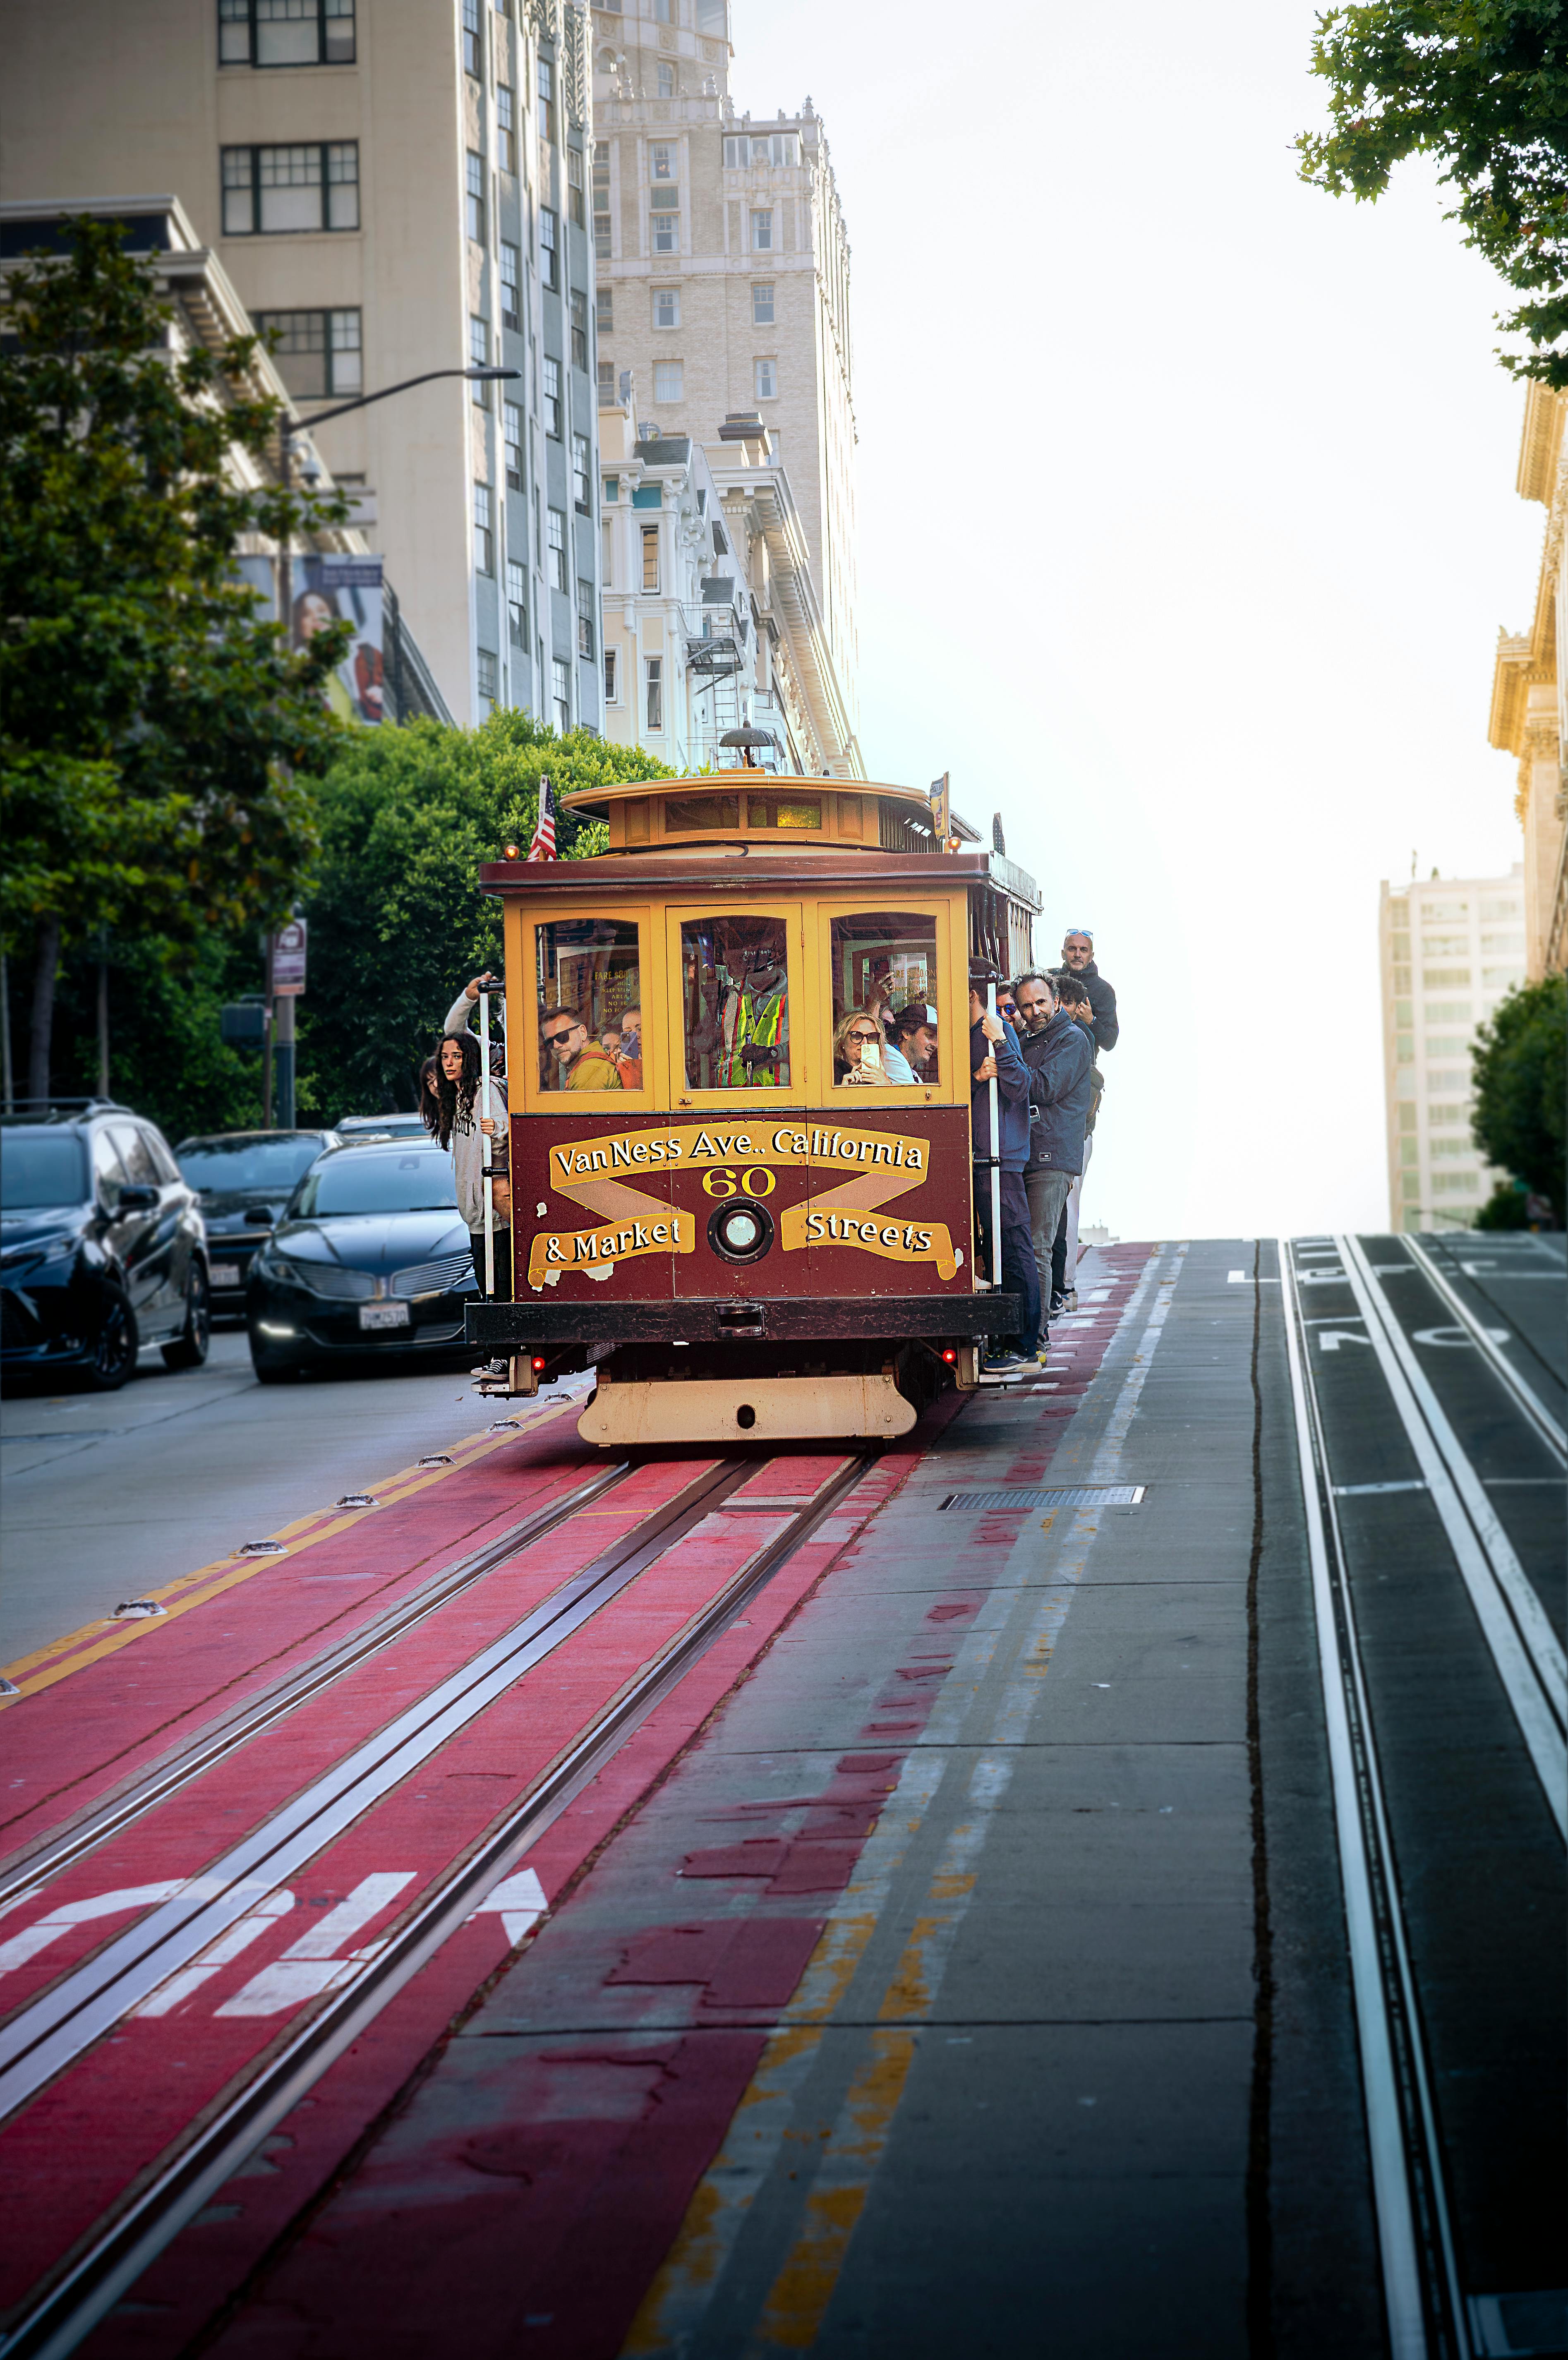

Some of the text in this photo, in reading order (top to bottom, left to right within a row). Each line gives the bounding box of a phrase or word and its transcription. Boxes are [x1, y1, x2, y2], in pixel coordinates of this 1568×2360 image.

[595, 971, 612, 980] FARE
[772, 1129, 923, 1170] California
[702, 1167, 776, 1197] 60
[545, 1218, 681, 1263] & Market
[806, 1213, 933, 1253] Streets
